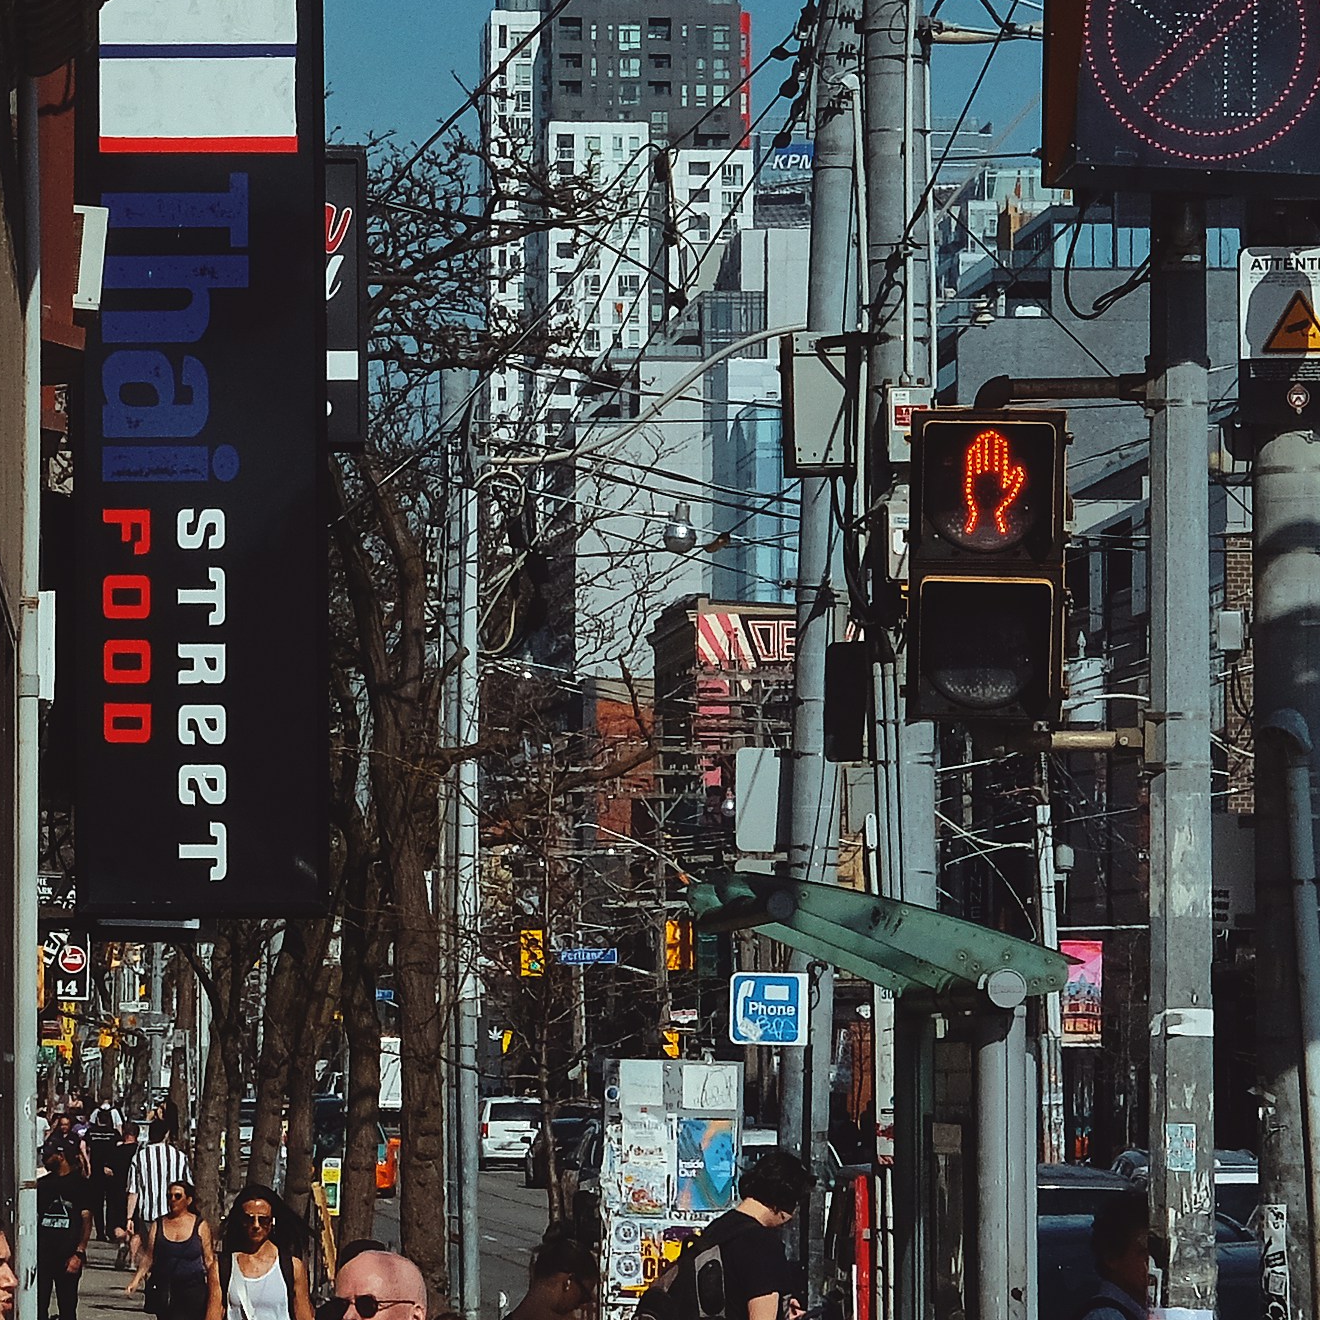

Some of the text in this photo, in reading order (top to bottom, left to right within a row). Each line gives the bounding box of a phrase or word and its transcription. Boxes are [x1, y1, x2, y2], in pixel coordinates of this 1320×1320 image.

[772, 153, 812, 170] KPM
[101, 172, 250, 482] Thai
[102, 508, 152, 744] FOOD
[748, 1001, 796, 1016] Phone
[679, 1168, 697, 1178] Out
